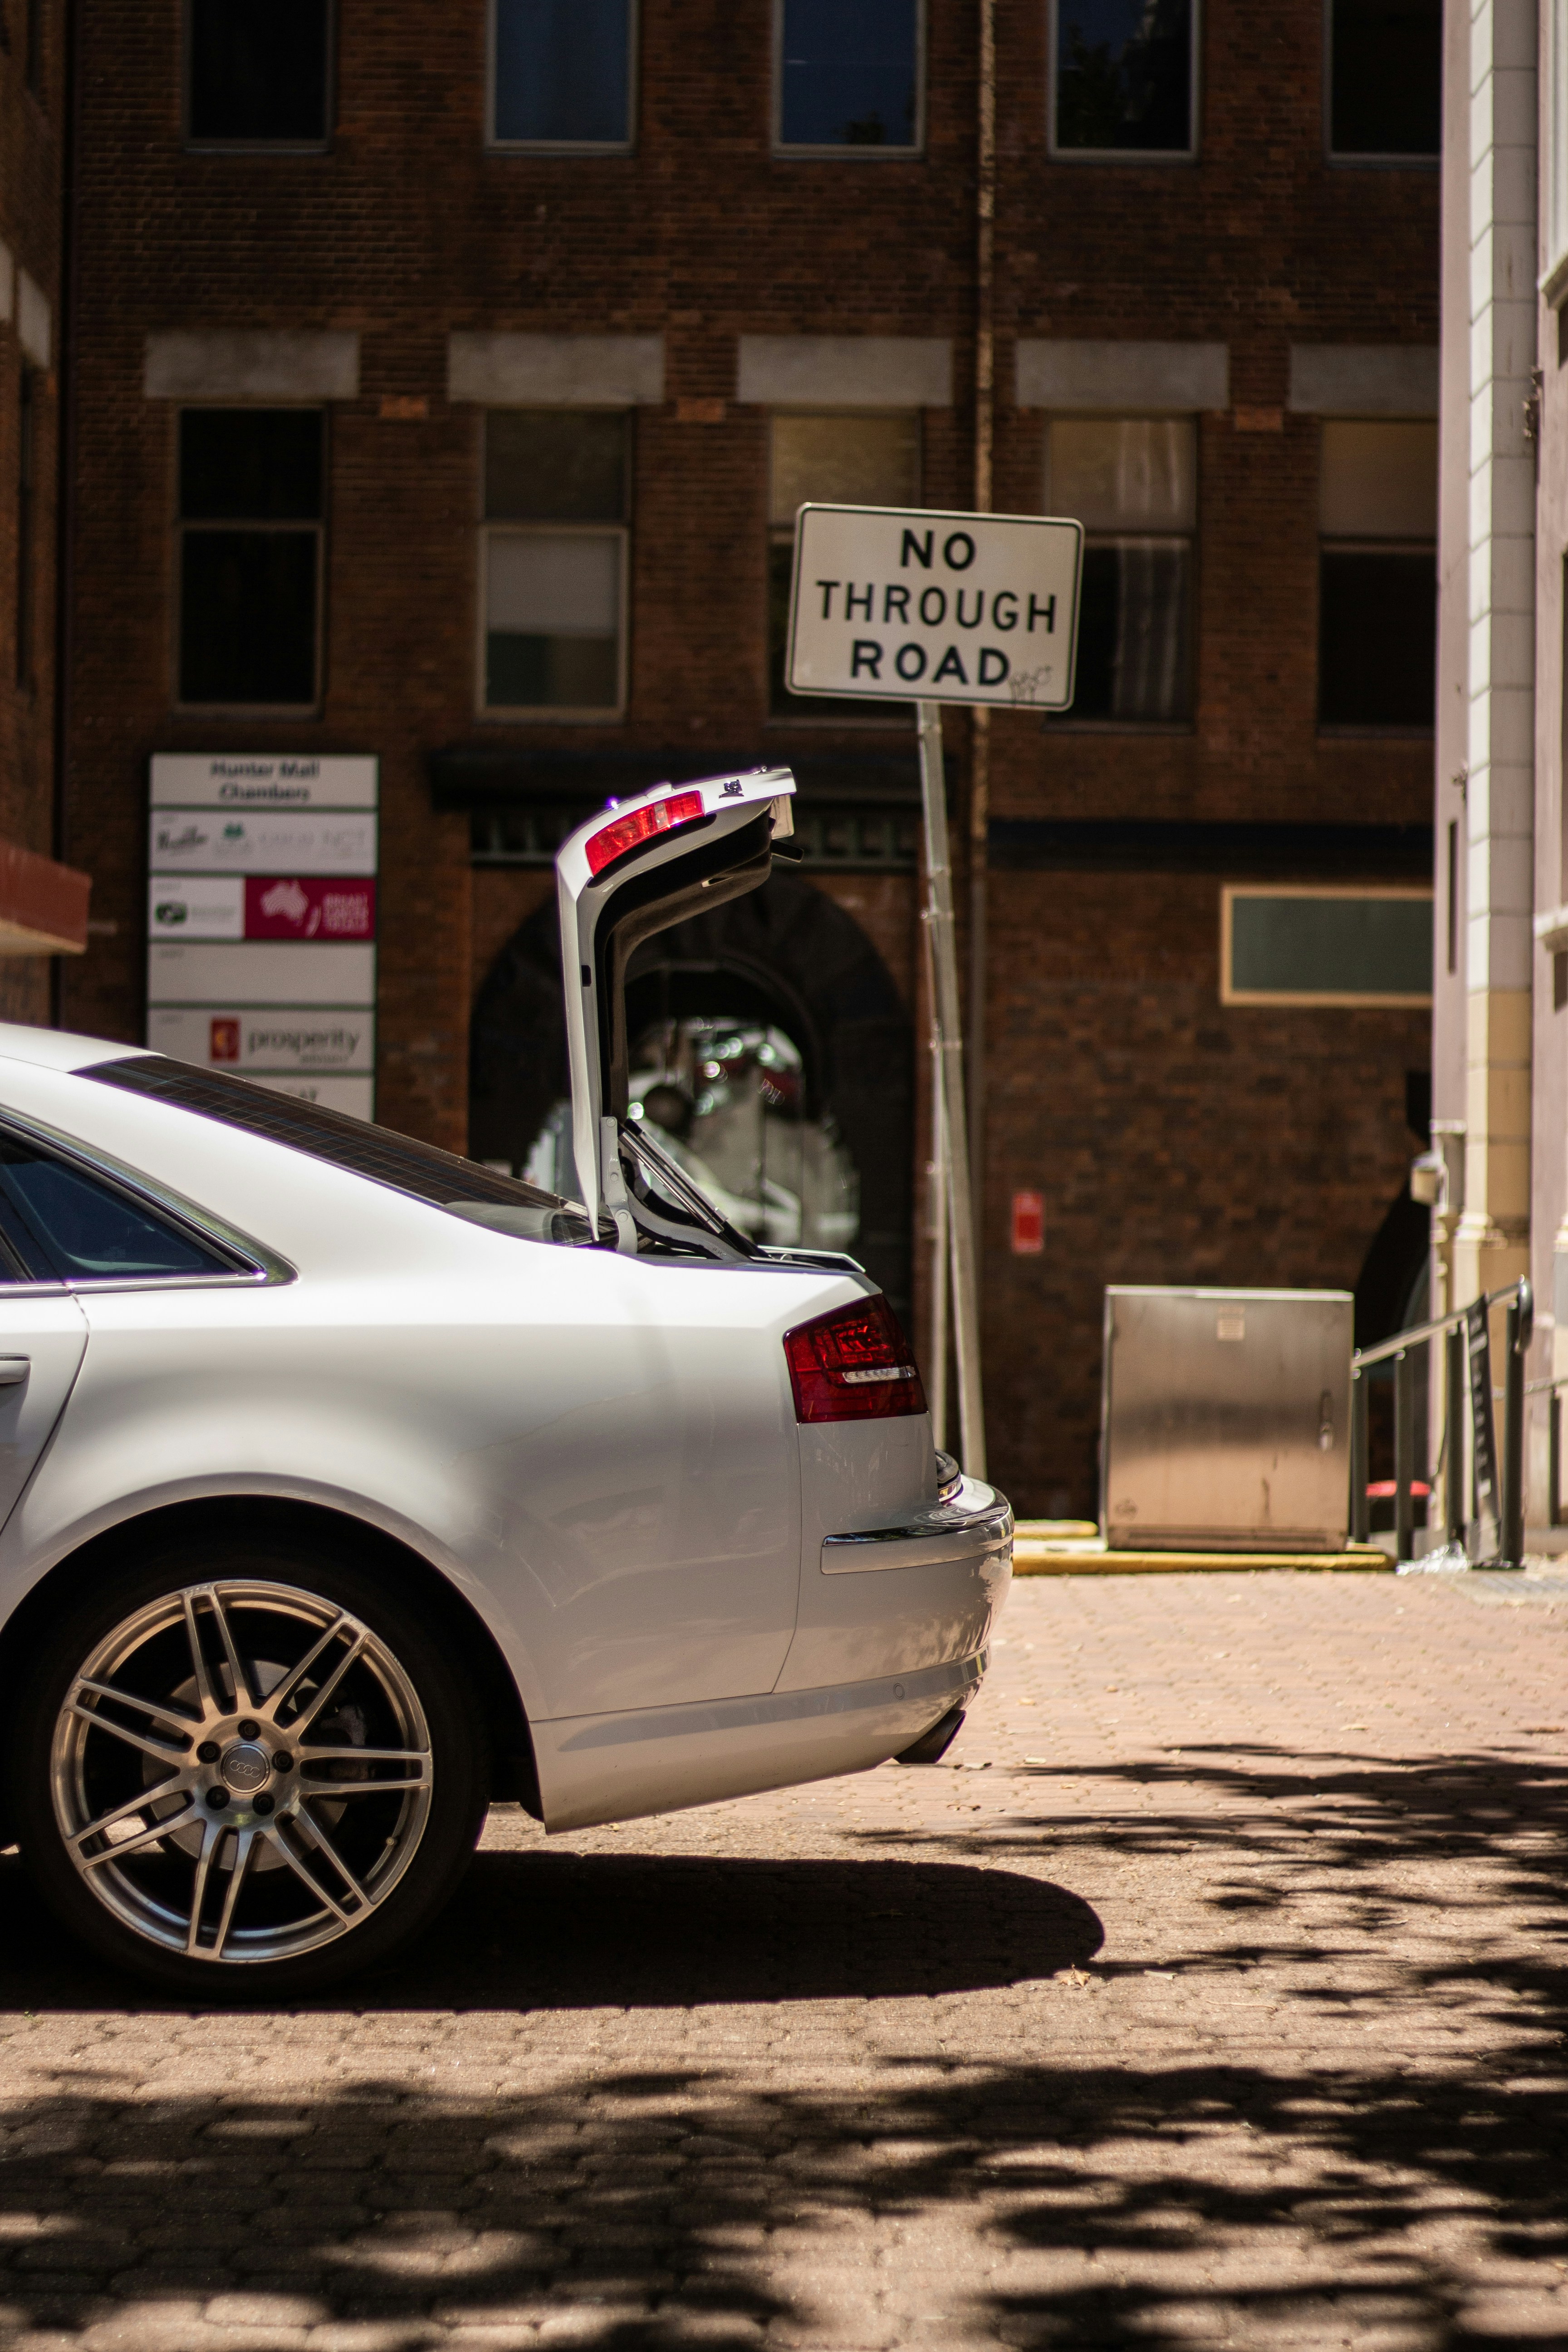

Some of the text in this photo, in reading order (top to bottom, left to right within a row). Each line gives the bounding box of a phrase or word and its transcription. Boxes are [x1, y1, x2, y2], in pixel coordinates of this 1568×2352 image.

[901, 528, 976, 571] NO
[817, 579, 1056, 633] THROUGH
[851, 639, 1009, 686] ROAD
[211, 760, 320, 777] Hunter Mall
[219, 783, 309, 801] Chambers
[248, 1026, 359, 1054] prosperity
